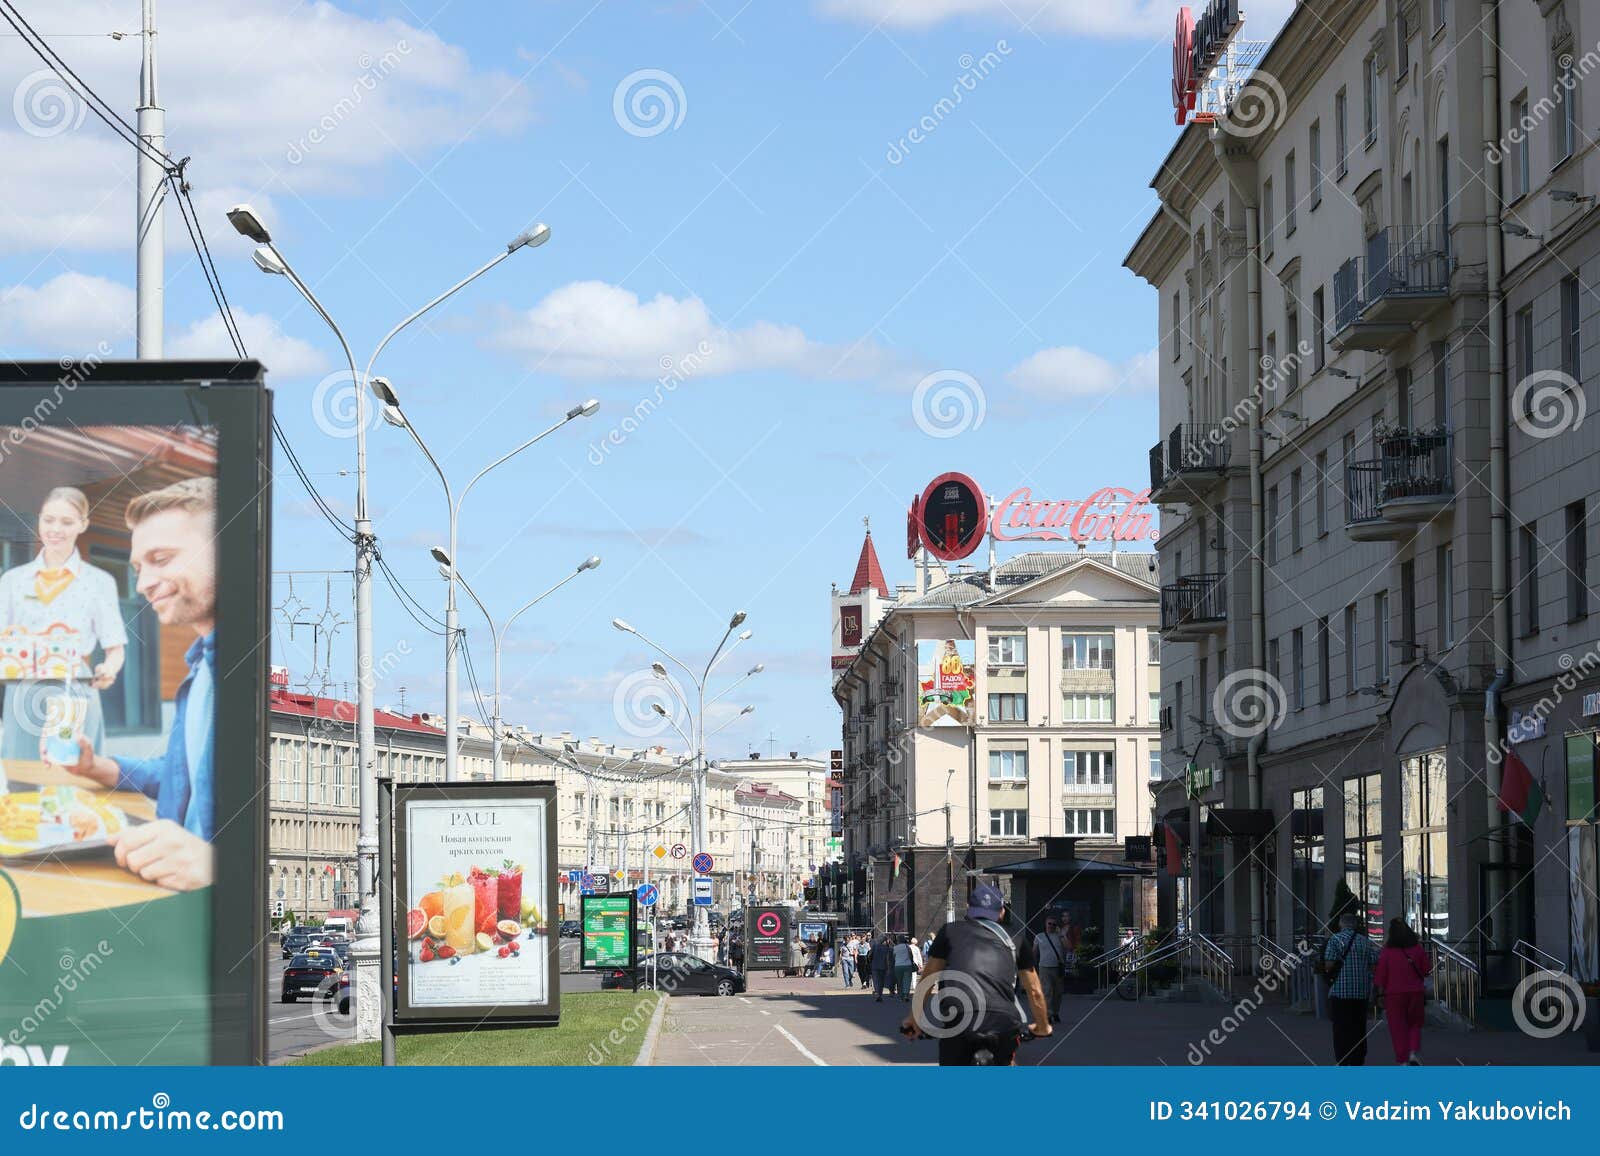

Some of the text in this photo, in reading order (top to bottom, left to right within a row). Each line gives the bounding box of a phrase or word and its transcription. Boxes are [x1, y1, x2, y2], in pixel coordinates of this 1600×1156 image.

[451, 812, 502, 826] PAUL
[440, 835, 467, 844] Новая
[449, 848, 474, 858] ярких
